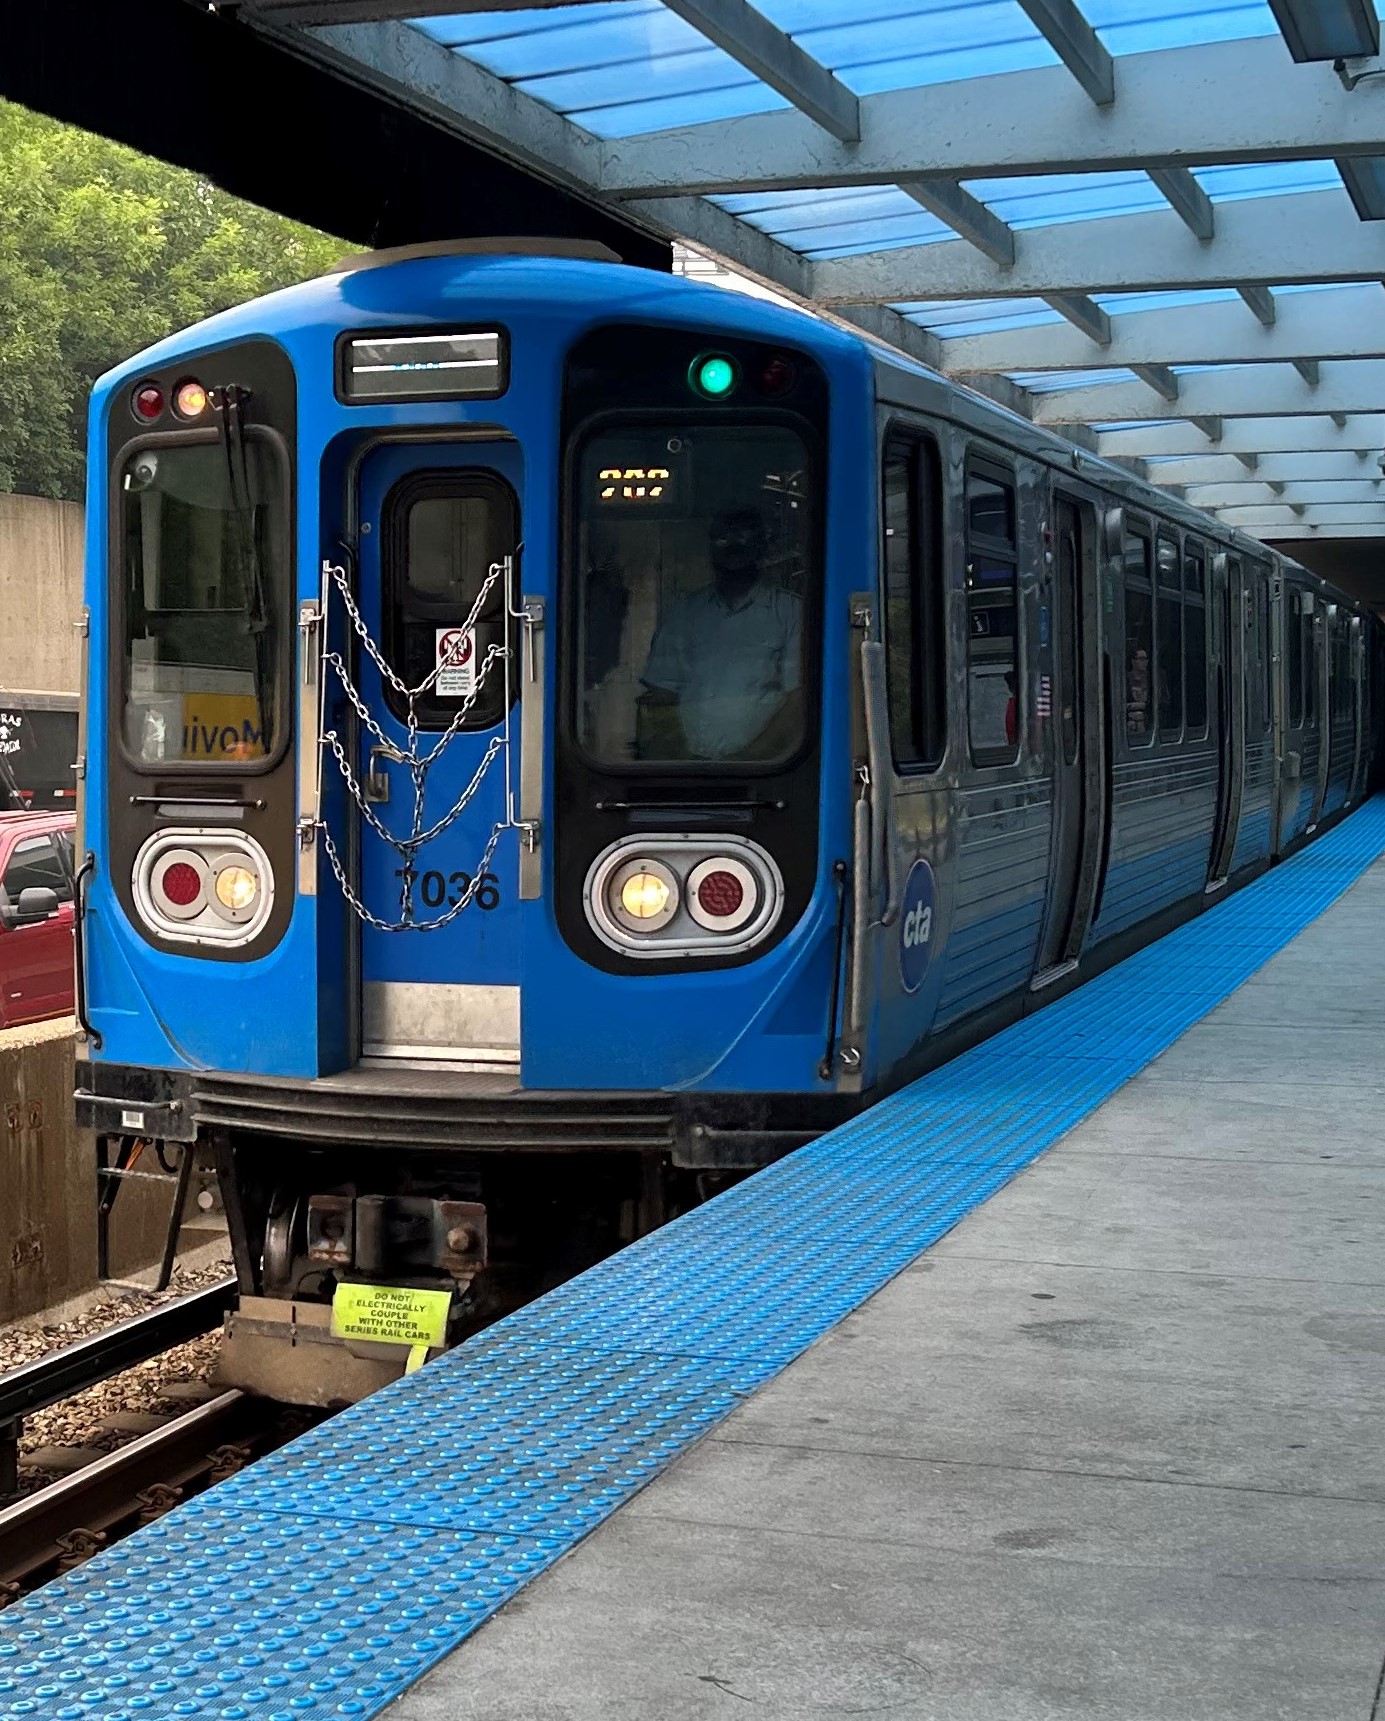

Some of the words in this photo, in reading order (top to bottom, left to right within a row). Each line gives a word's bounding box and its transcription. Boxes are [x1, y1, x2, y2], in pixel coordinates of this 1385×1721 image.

[394, 869, 500, 911] 7036
[903, 900, 932, 948] cta
[374, 1292, 389, 1300] DO
[390, 1294, 411, 1302] NOT
[356, 1299, 427, 1312] ELECTRICALLY
[370, 1310, 409, 1320] COUPLE
[358, 1317, 384, 1327] WITH
[385, 1319, 418, 1330] OTHER
[344, 1325, 378, 1335] SERIES
[380, 1328, 403, 1338] RAIL
[404, 1331, 431, 1341] CARS
